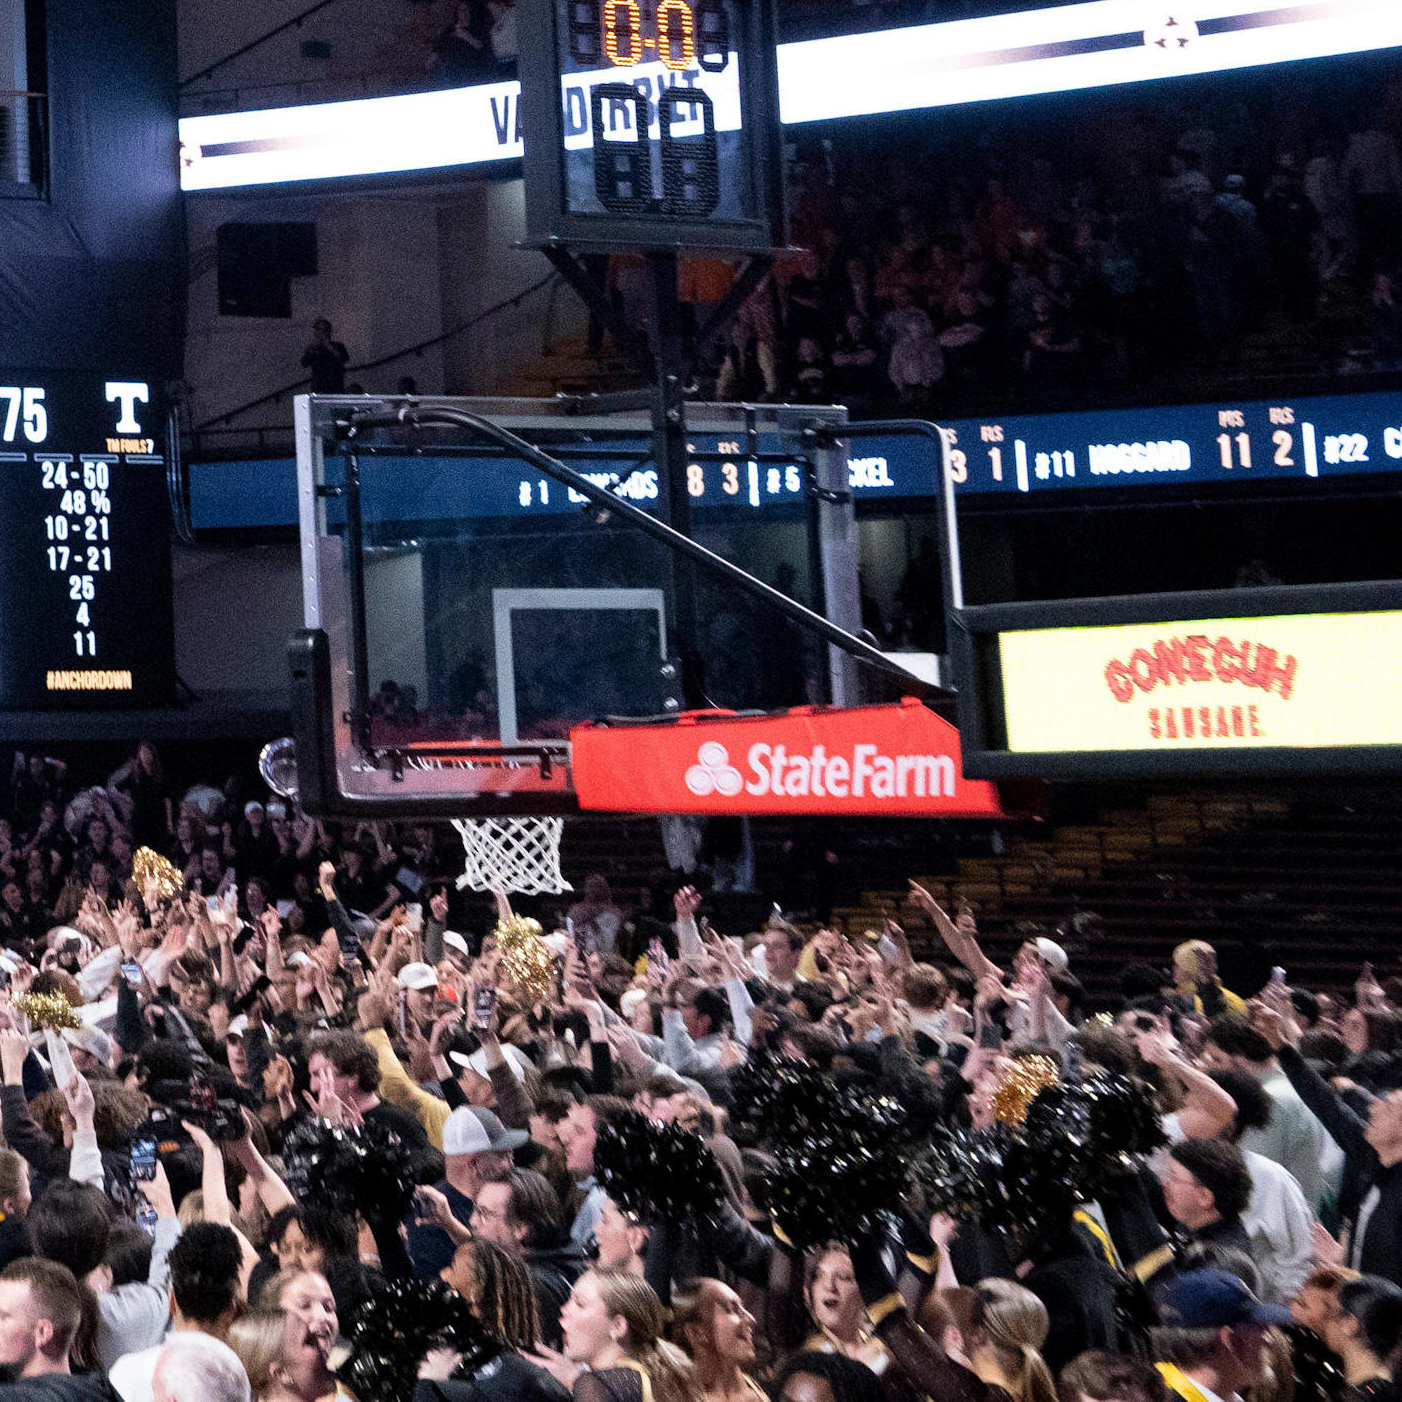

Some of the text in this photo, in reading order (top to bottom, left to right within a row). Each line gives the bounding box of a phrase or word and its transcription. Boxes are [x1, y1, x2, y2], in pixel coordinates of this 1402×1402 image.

[105, 381, 149, 434] T
[1034, 450, 1076, 480] #11
[1216, 432, 1252, 470] 11
[1272, 429, 1294, 467] 2
[1323, 433, 1369, 464] #22
[721, 462, 739, 495] 3
[767, 466, 801, 494] #5
[987, 446, 1004, 482] 1
[60, 489, 111, 515] 48 %
[69, 575, 95, 600] 25
[75, 601, 90, 627] 4
[73, 630, 96, 657] 11
[46, 669, 133, 691] #ANCHORDOWN
